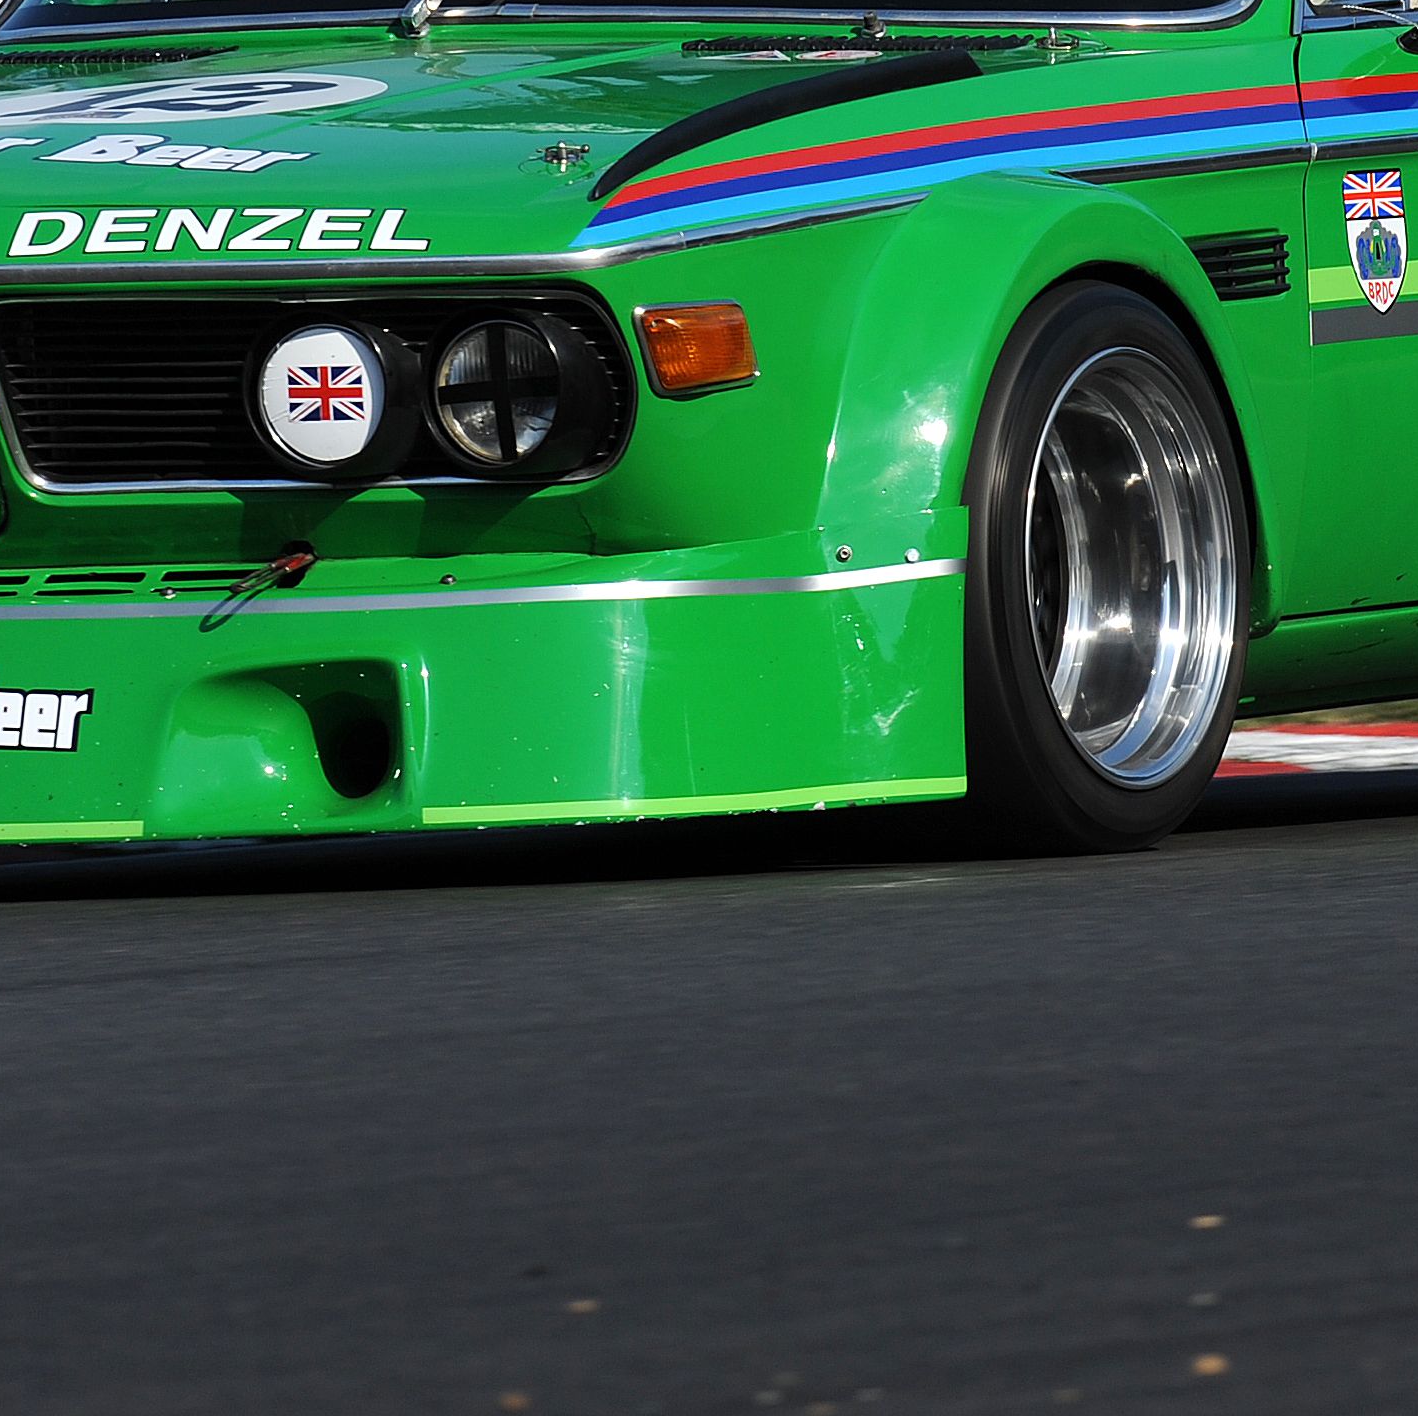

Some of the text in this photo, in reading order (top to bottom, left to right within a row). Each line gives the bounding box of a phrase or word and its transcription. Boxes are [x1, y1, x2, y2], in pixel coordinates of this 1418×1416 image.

[33, 133, 319, 173] Beer
[7, 206, 431, 259] DENZEL
[1368, 280, 1395, 305] BRDC
